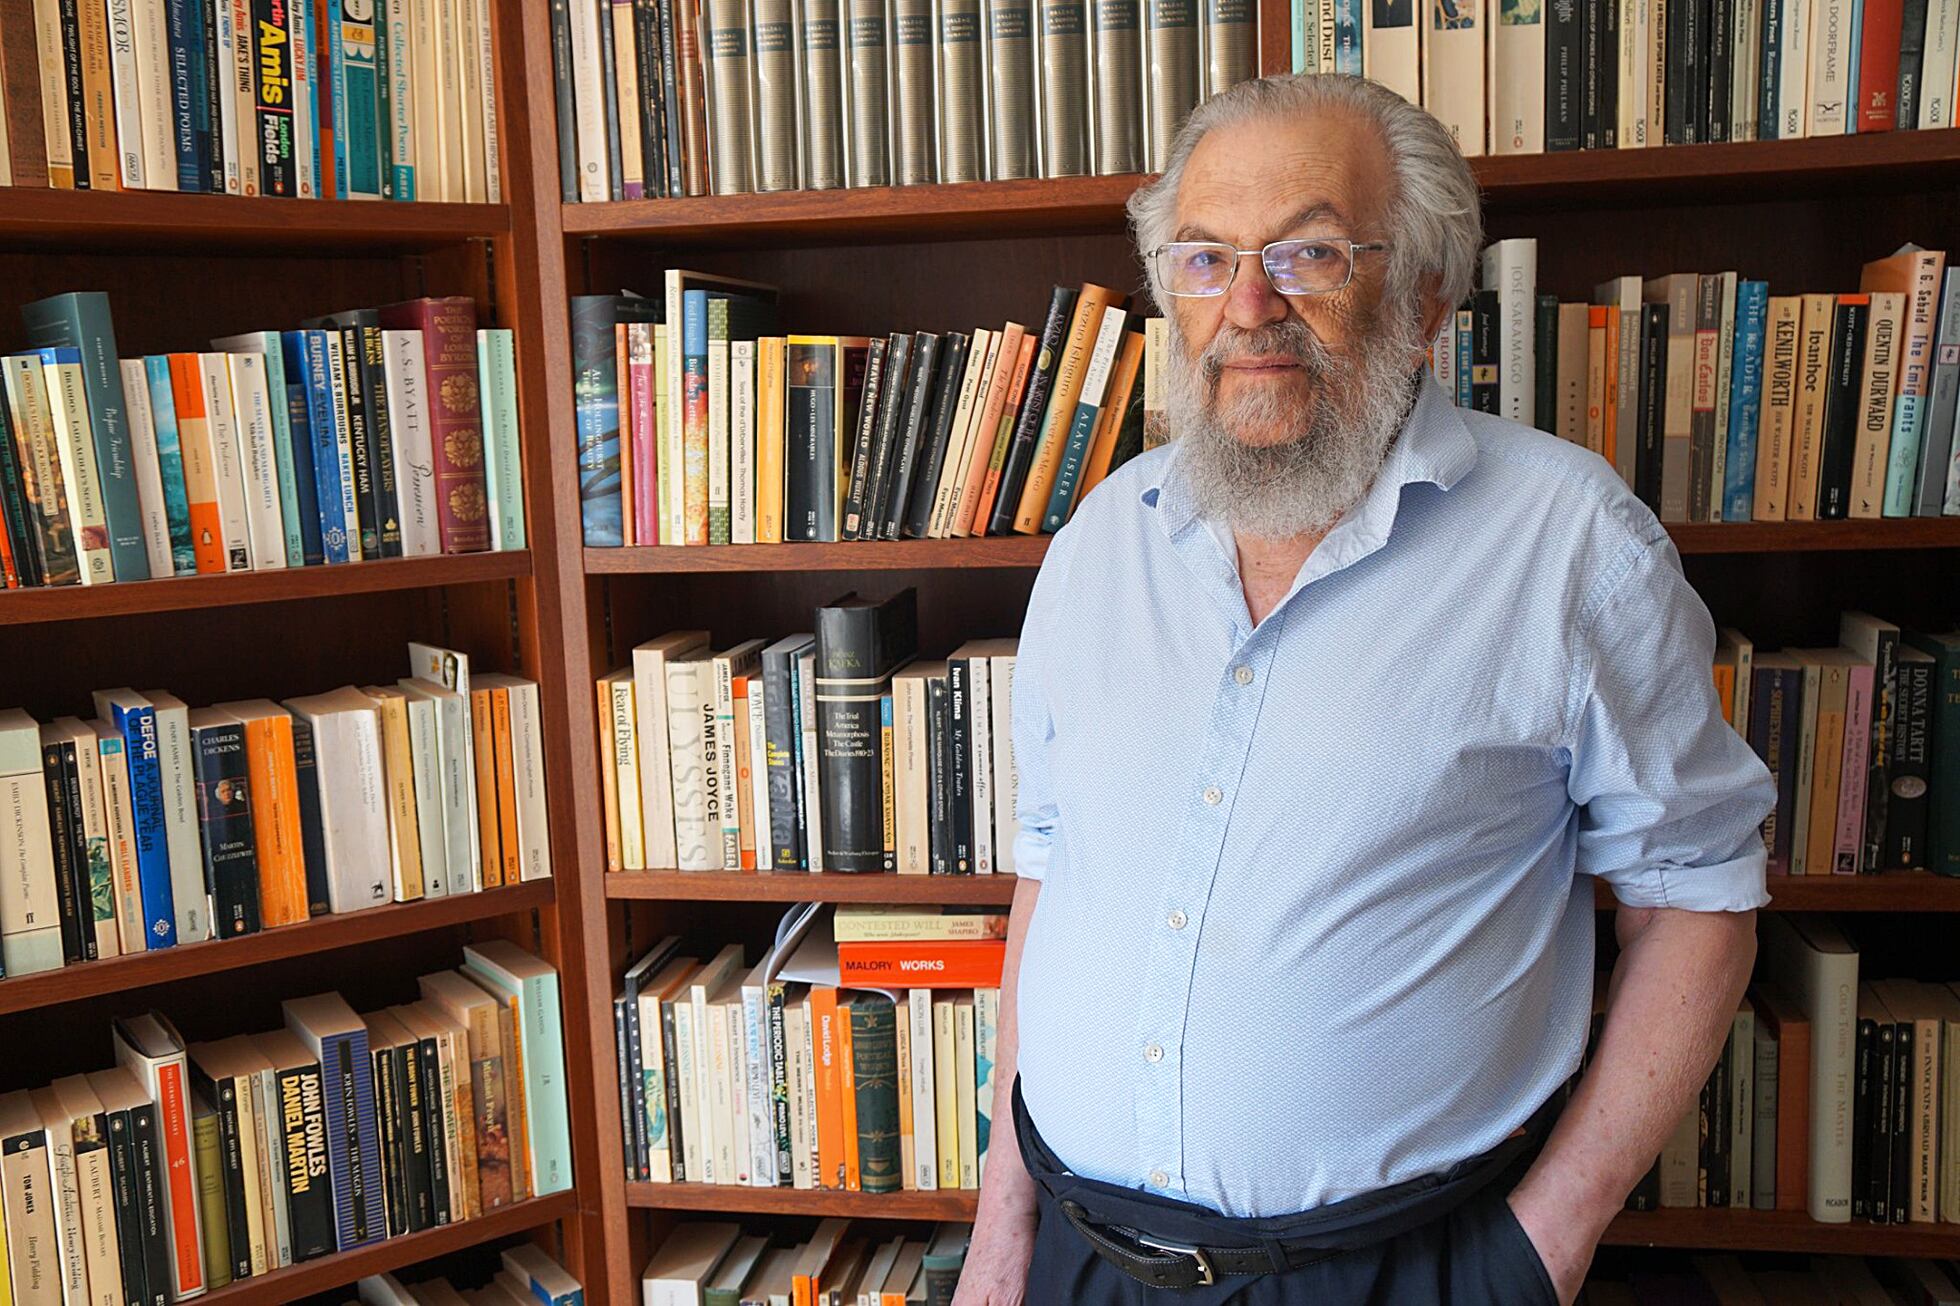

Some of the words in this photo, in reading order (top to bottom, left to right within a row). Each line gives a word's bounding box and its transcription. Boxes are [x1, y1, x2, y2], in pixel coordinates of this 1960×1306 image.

[235, 10, 248, 30] Amis
[293, 14, 302, 34] Amis
[236, 35, 249, 63] JAKE'S
[294, 38, 304, 63] LUCKY
[393, 22, 406, 77] Collected
[1307, 22, 1315, 67] Selected
[1322, 26, 1333, 61] Dust
[1826, 6, 1838, 82] DOORFRAME
[260, 20, 288, 104] Amis
[295, 65, 305, 80] JIM
[176, 47, 188, 109] SELECTED
[239, 66, 251, 92] THING
[396, 80, 407, 124] Shorter
[1560, 79, 1568, 122] PULLMAN
[1930, 97, 1941, 123] PICADOR
[179, 112, 192, 152] POEMS
[1787, 109, 1797, 134] PICADOR
[264, 115, 279, 164] Fields
[280, 117, 289, 158] London
[398, 125, 408, 162] Poems
[399, 168, 408, 198] FABER
[1921, 257, 1935, 268] W.
[1511, 266, 1525, 294] JOSÉ
[1921, 275, 1933, 284] G.
[1076, 300, 1096, 341] Kazuo
[1747, 295, 1760, 325] THE
[1915, 291, 1930, 323] Sebald
[364, 327, 374, 365] BURGESS
[401, 338, 411, 351] A.
[971, 349, 980, 366] Ibsen
[1440, 336, 1449, 379] BLOOD
[1511, 302, 1522, 383] SARAMAGO
[1699, 338, 1713, 359] Don
[1875, 320, 1893, 365] QUENTIN
[1910, 333, 1928, 356] The
[311, 335, 326, 389] BURNEY
[331, 343, 342, 379] WILLIAM
[403, 358, 414, 371] S.
[867, 357, 880, 389] BRAVE
[1058, 345, 1082, 396] Ishiguro
[1742, 333, 1757, 394] READER
[1771, 320, 1795, 406] KENILWORTH
[1805, 331, 1824, 392] Ivanhoe
[64, 371, 76, 413] BRADDON
[334, 381, 343, 389] S.
[592, 369, 602, 394] ALAN
[687, 358, 697, 396] Birthday
[965, 379, 973, 392] Peer
[978, 380, 987, 398] Brand
[1698, 363, 1711, 402] Carlos
[374, 382, 384, 405] THE
[404, 378, 418, 432] BYATT
[865, 392, 875, 412] NEW
[961, 395, 969, 409] Gynt
[1867, 371, 1891, 431] DURWARD
[1901, 365, 1924, 433] Emigrants
[72, 420, 83, 444] LADY
[316, 392, 330, 447] EVELINA
[335, 392, 347, 444] BURROUGHS
[593, 398, 604, 469] HOLLINGHURST
[860, 416, 873, 448] WORLD
[1049, 408, 1064, 438] Never
[1072, 413, 1088, 448] ALAN
[249, 422, 257, 447] Mikhail
[353, 414, 367, 466] KENTUCKY
[808, 424, 816, 460] MISÉRABLES
[1044, 439, 1056, 456] Let
[76, 446, 87, 485] AUDLEY'S
[106, 437, 123, 478] Friendship
[377, 409, 393, 492] PIANOPLAYERS
[586, 435, 596, 469] BEAUTY
[856, 454, 865, 478] ALDOUS
[1041, 459, 1051, 472] Me
[341, 453, 352, 481] NAKED
[358, 469, 369, 492] HAM
[739, 468, 747, 496] Thomas
[1032, 474, 1047, 491] Go
[1059, 457, 1078, 495] ISLER
[83, 487, 93, 518] SECRET
[344, 485, 354, 512] LUNCH
[852, 480, 863, 504] HUXLEY
[940, 487, 949, 502] Eyre
[737, 498, 746, 520] Hardy
[934, 504, 945, 530] Methuen
[953, 667, 962, 688] Ivan
[1912, 668, 1928, 715] DONNA
[615, 687, 627, 712] Fear
[128, 719, 139, 735] OF
[617, 714, 629, 725] of
[703, 704, 716, 760] JAMES
[130, 737, 141, 762] THE
[141, 716, 155, 759] DEFOE
[202, 734, 239, 745] CHARLES
[616, 729, 632, 765] Flying
[1910, 719, 1925, 762] TARTT
[146, 762, 156, 770] A
[668, 668, 707, 863] ULYSSES
[722, 744, 733, 790] Finnegans
[955, 743, 963, 769] Golden
[11, 782, 22, 803] EMILY
[131, 766, 148, 816] PLAGUE
[147, 773, 161, 831] JOURNAL
[705, 767, 719, 821] JOYCE
[723, 793, 733, 818] Wake
[770, 765, 795, 845] kafka
[13, 806, 25, 846] DICKINSON
[139, 820, 152, 851] YEAR
[120, 840, 129, 856] MOLL
[725, 834, 736, 866] FABER
[122, 859, 132, 891] FLANDERS
[913, 920, 942, 930] WILL
[846, 961, 892, 971] MALORY
[900, 960, 944, 971] WORKS
[772, 1007, 781, 1020] THE
[773, 1022, 783, 1059] PERIODIC
[823, 1040, 831, 1066] Lodge
[344, 1072, 353, 1096] JOHN
[442, 1065, 451, 1086] THE
[483, 1061, 496, 1099] Michael
[775, 1061, 785, 1084] TABLE
[1922, 1054, 1932, 1108] INNOCENTS
[281, 1076, 302, 1132] DANIEL
[304, 1074, 320, 1112] JOHN
[444, 1090, 453, 1112] TIN
[346, 1098, 357, 1133] FOWLES
[446, 1117, 455, 1139] MEN
[485, 1103, 501, 1133] Frayn
[307, 1114, 326, 1176] FOWLES
[1921, 1113, 1931, 1150] ABROAD
[287, 1134, 309, 1193] MARTIN
[350, 1147, 358, 1163] THE
[23, 1174, 33, 1190] TOM
[88, 1154, 101, 1199] FLAUBERT
[351, 1166, 362, 1196] MAGUS
[1920, 1177, 1928, 1199] TWAIN
[24, 1192, 35, 1214] JONES
[28, 1236, 39, 1257] Henry
[29, 1260, 40, 1290] Fielding
